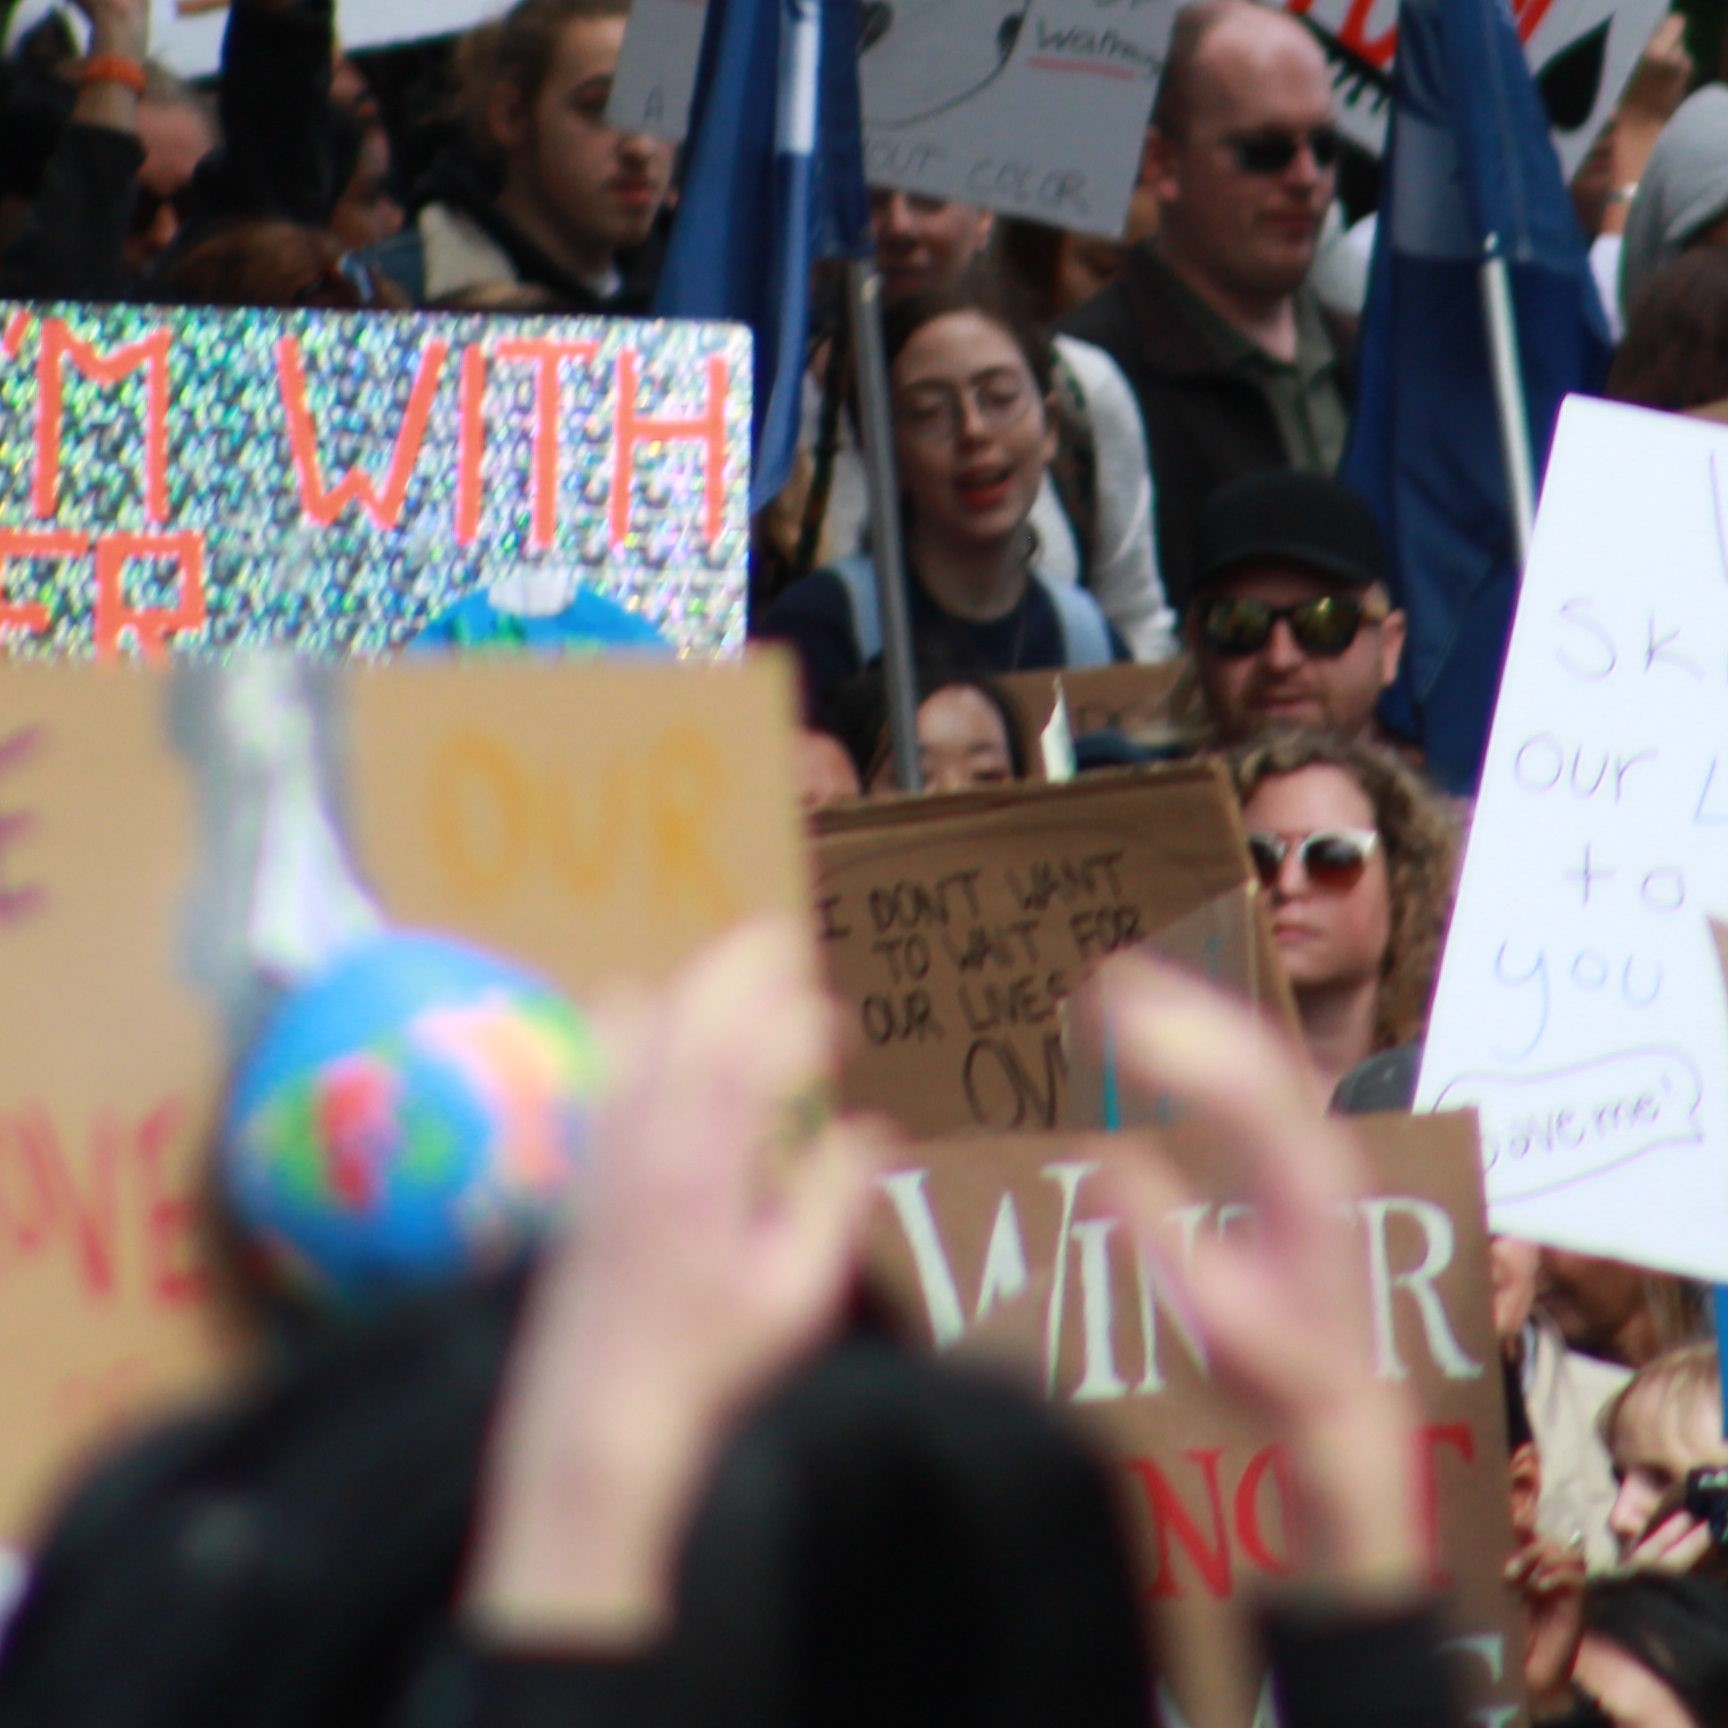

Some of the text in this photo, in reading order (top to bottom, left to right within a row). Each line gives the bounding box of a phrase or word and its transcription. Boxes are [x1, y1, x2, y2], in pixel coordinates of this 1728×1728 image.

[274, 333, 730, 553] WITH
[1565, 847, 1688, 915] to
[871, 932, 932, 986] TO
[1494, 938, 1664, 1063] you
[861, 989, 945, 1046] OUR
[874, 1157, 1484, 1406] WINR
